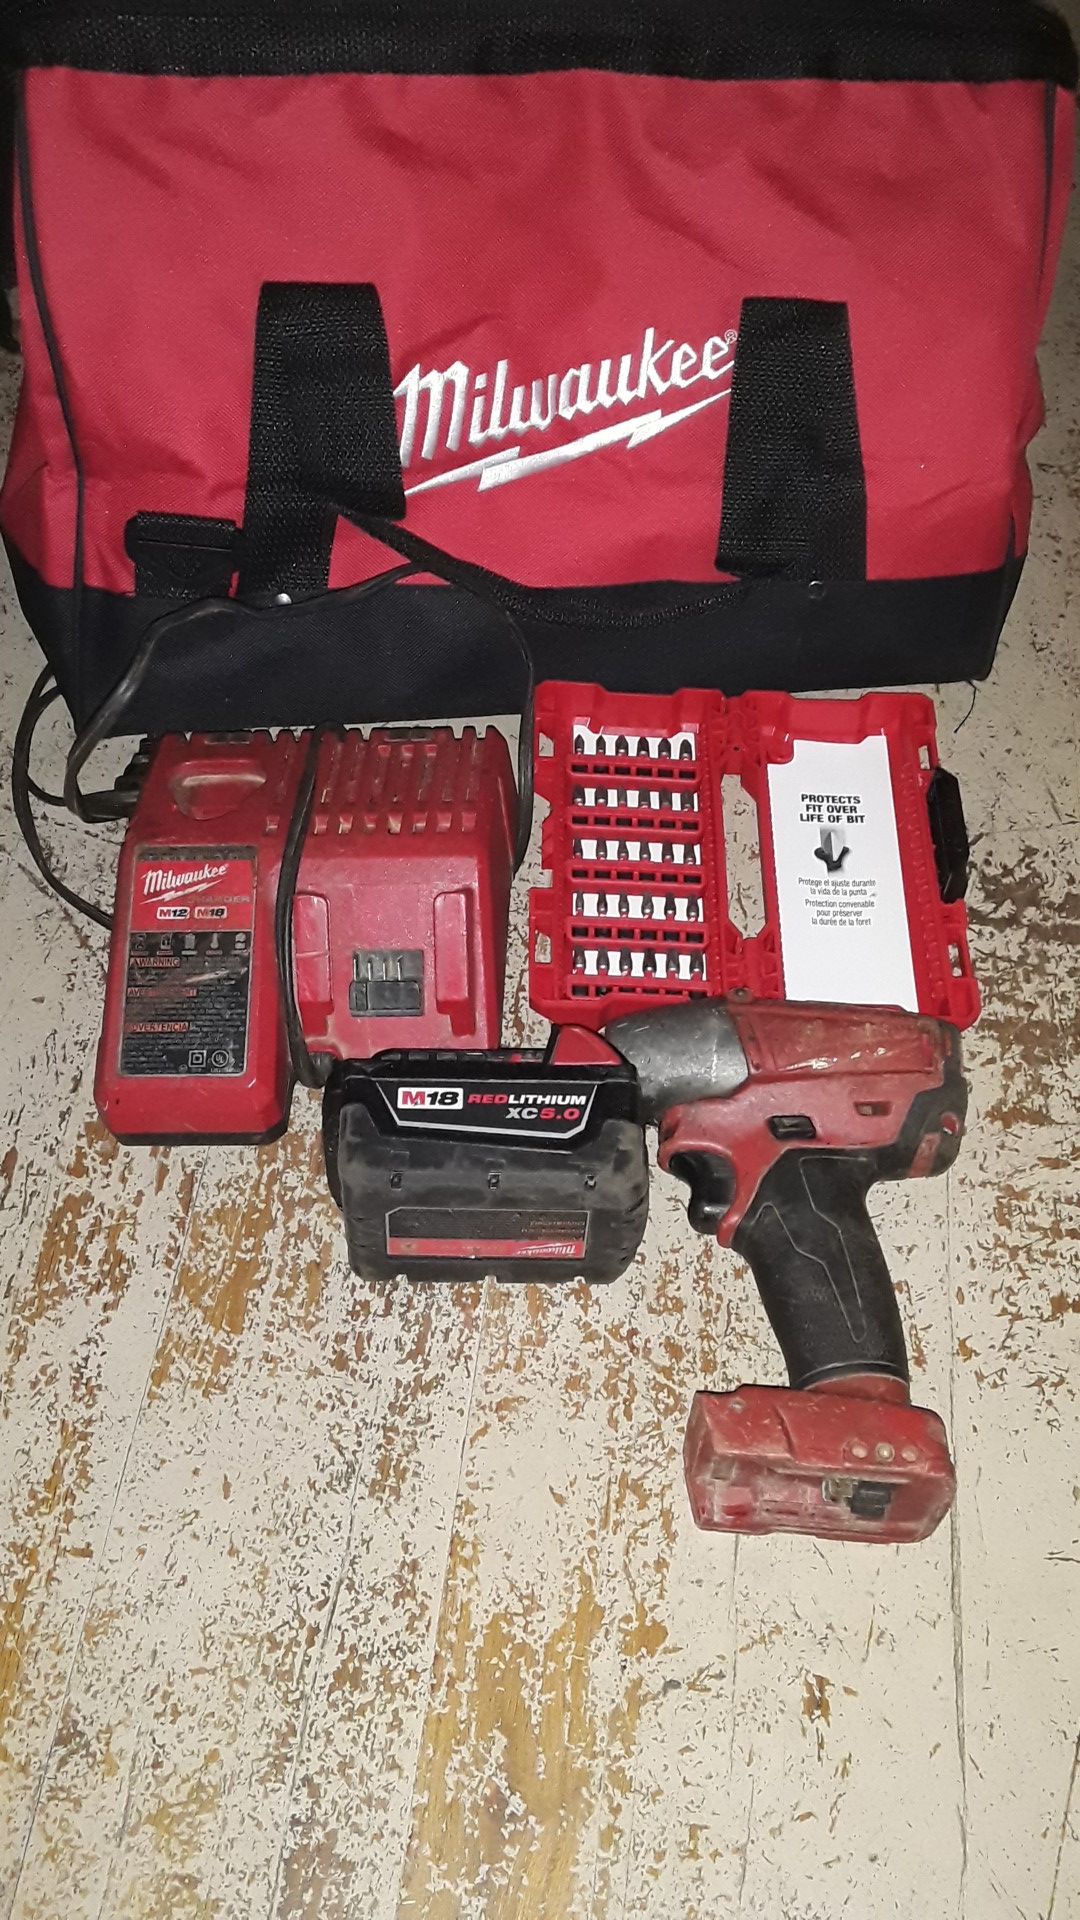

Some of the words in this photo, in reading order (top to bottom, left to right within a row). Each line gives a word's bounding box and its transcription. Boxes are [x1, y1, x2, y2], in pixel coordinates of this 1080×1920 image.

[393, 326, 736, 469] Milwaukee
[800, 793, 861, 804] PROTECTS
[806, 803, 823, 813] FIT
[826, 804, 858, 814] OVER
[799, 813, 825, 823] LIFE
[827, 814, 843, 823] OF
[846, 815, 865, 823] BIT
[140, 863, 228, 896] Milwaukee
[798, 877, 823, 888] Protege
[831, 879, 851, 890] ajuste
[851, 879, 877, 887] durante
[810, 887, 816, 895] la
[817, 887, 831, 895] vida
[832, 888, 840, 896] de
[841, 888, 848, 896] la
[848, 888, 868, 897] punta
[805, 898, 838, 908] Protection
[838, 899, 875, 908] convenable
[159, 908, 188, 918] M12
[196, 908, 226, 918] M18
[816, 909, 831, 918] pour
[832, 909, 863, 918] préserver
[811, 917, 818, 925] la
[818, 917, 838, 926] durée
[838, 918, 847, 926] de
[848, 918, 855, 926] la
[855, 918, 871, 926] foret
[139, 957, 181, 968] WARNING
[401, 1090, 460, 1107] M18
[467, 1093, 587, 1106] REDLITHIUM
[505, 1106, 581, 1121] XC5.0
